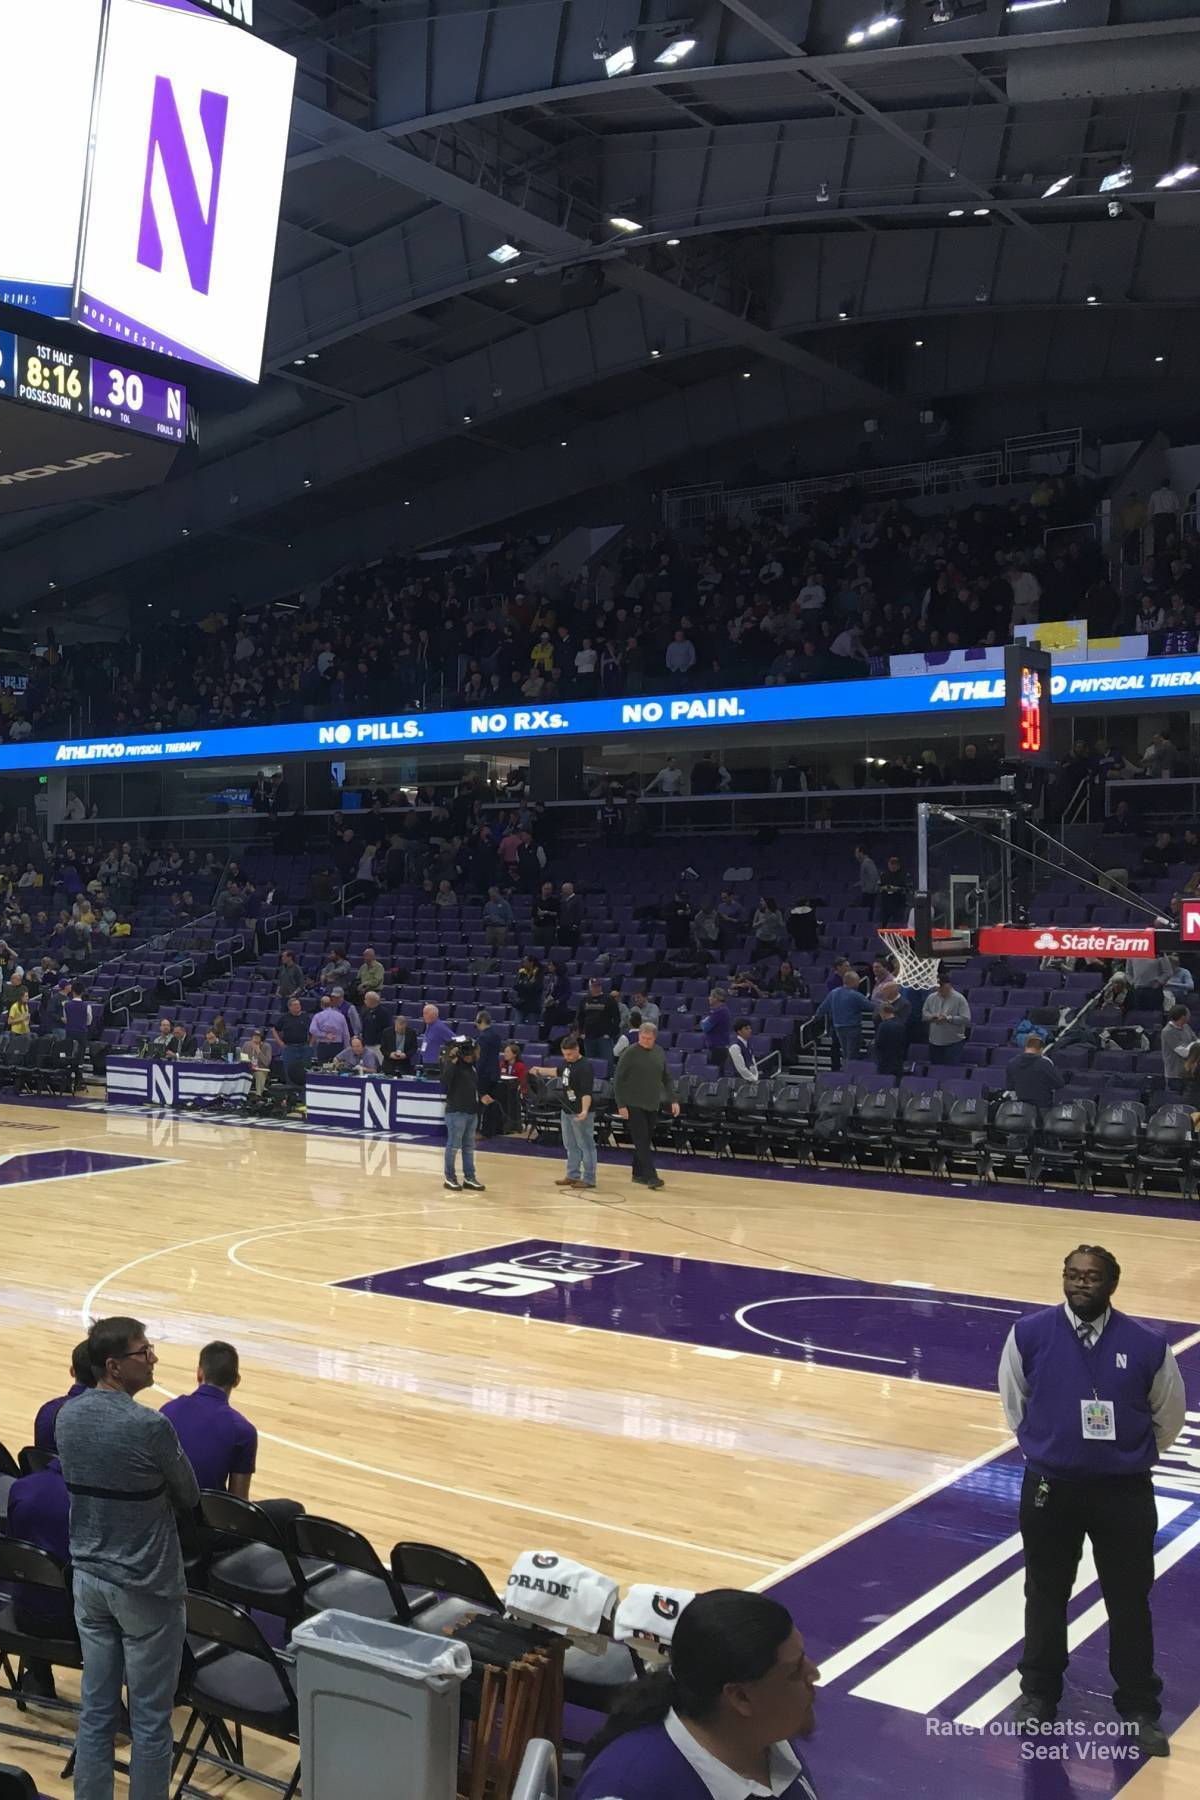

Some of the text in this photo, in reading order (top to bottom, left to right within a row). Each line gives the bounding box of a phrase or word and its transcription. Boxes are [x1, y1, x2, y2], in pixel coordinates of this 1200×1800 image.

[137, 75, 229, 296] N
[37, 345, 73, 366] 1ST HALF
[27, 356, 81, 398] 8:16
[19, 385, 71, 410] POSSESSION
[108, 369, 143, 411] 30
[168, 387, 181, 420] N
[157, 423, 173, 436] FOULS
[1070, 675, 1145, 693] PHYSICAL
[471, 710, 569, 734] NO RXs.
[622, 697, 745, 723] NO PAIN.
[318, 720, 424, 745] NO PILLS.
[55, 741, 202, 761] ATHLETICO PHYSICAL THERAPY
[152, 1064, 173, 1105] N
[364, 1082, 391, 1129] N
[1115, 1353, 1128, 1369] N
